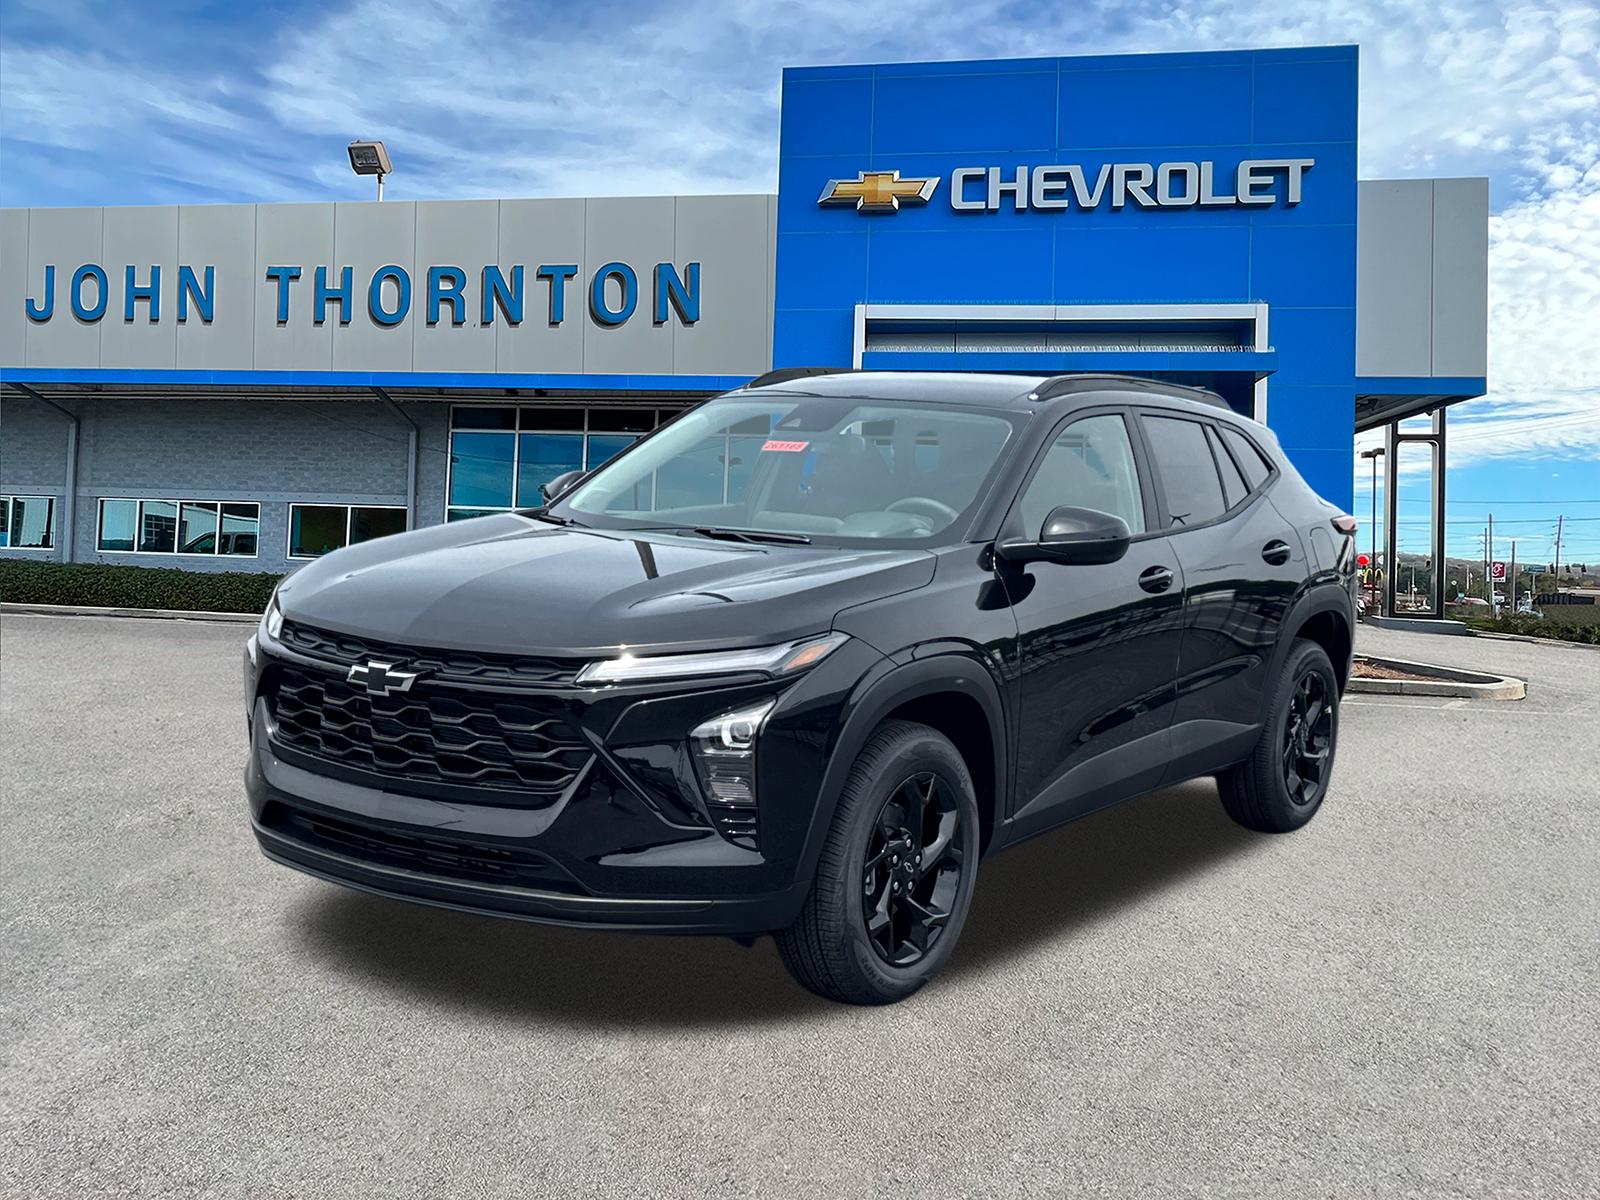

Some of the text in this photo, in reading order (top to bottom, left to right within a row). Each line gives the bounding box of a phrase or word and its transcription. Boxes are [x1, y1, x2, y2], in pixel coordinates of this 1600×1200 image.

[950, 158, 1316, 212] CHEVROLET
[25, 261, 702, 327] JOHN THORNTON
